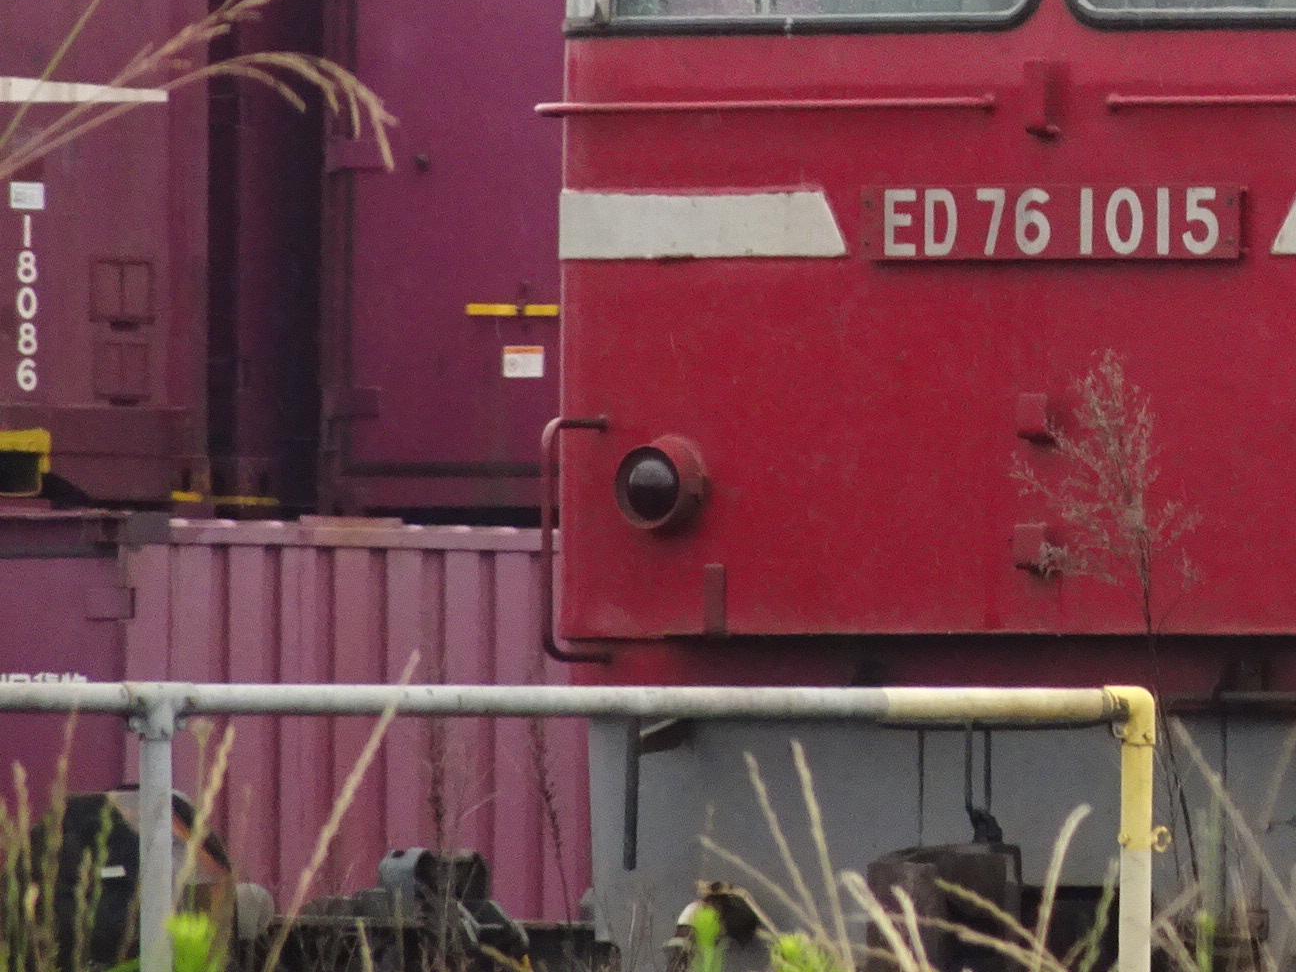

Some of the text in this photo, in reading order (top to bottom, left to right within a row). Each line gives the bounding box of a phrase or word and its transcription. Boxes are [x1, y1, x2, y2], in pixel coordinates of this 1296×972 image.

[884, 187, 1220, 256] ED 76 1015
[16, 214, 38, 391] 18086
